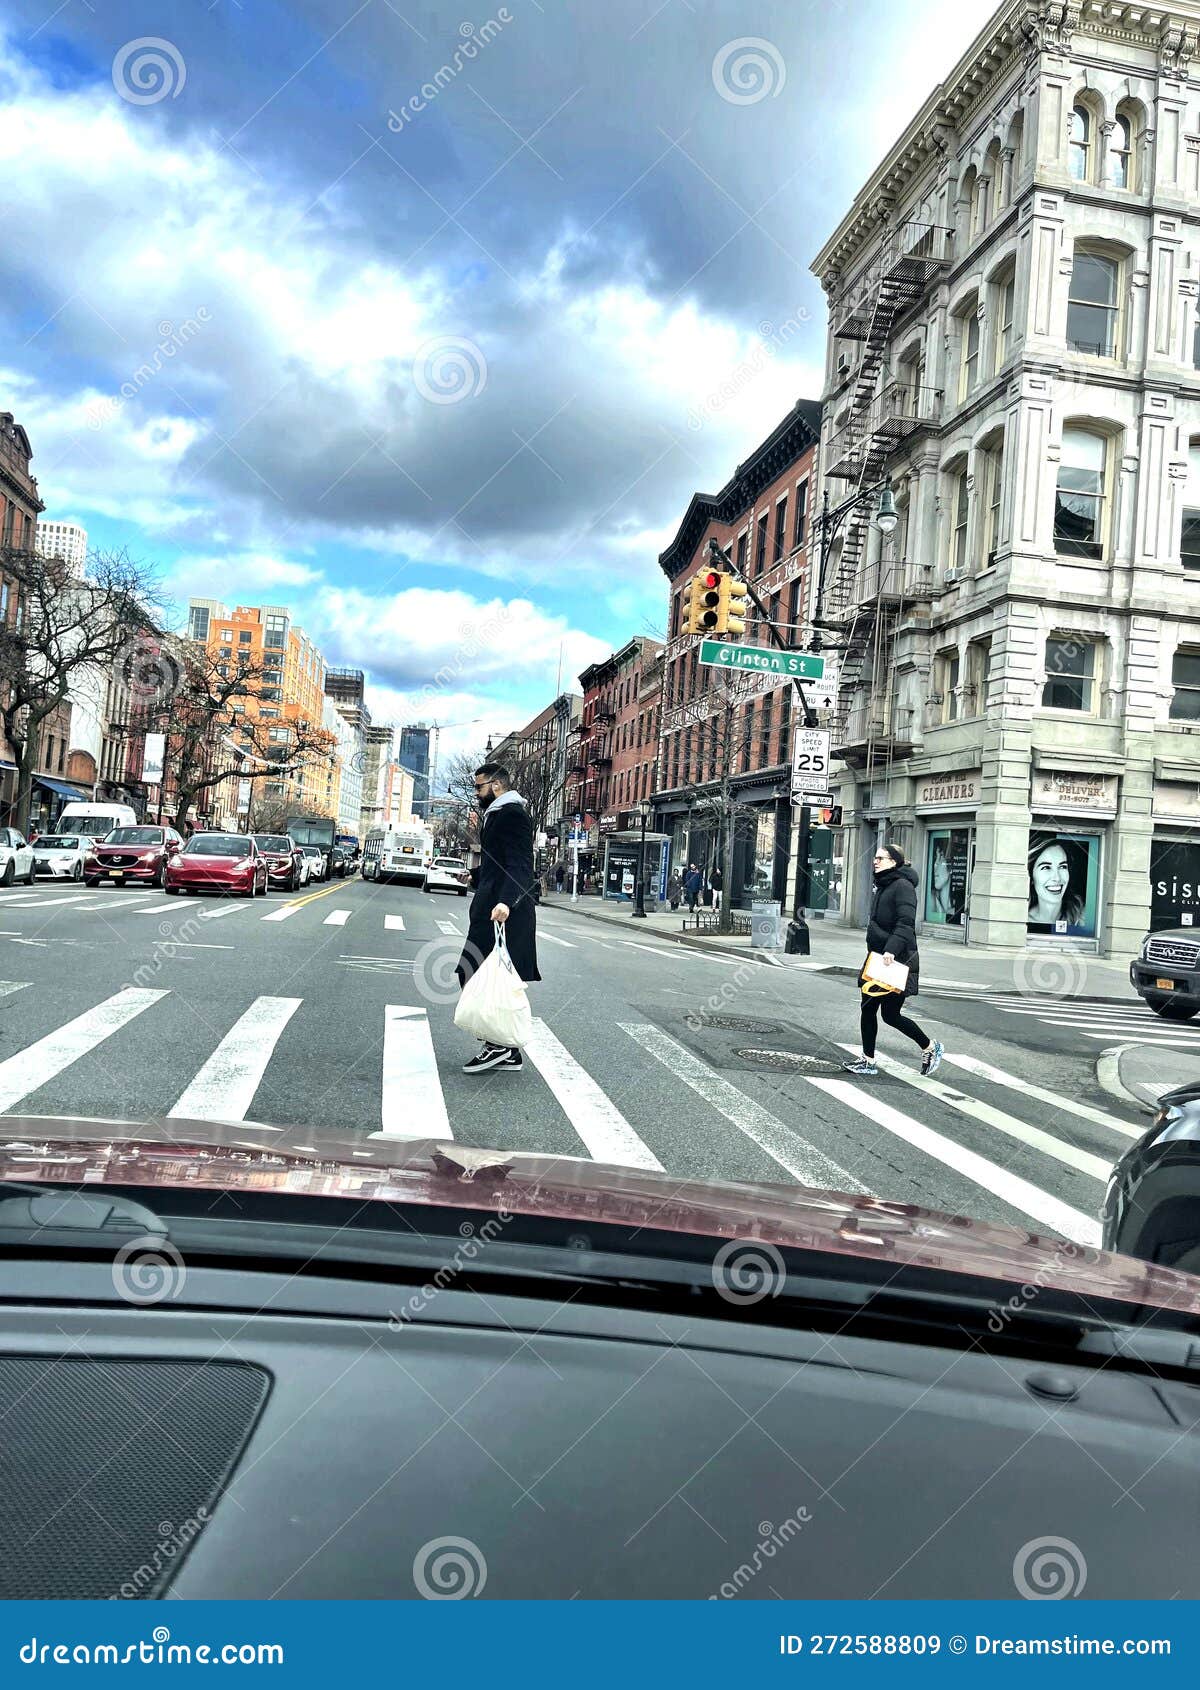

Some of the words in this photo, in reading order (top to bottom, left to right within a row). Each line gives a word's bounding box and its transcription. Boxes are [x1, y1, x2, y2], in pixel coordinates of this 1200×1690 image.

[719, 648, 780, 669] Clinton
[788, 658, 806, 673] St
[816, 682, 835, 691] ROUTE
[796, 696, 816, 705] TRU
[801, 738, 822, 746] SPEED
[798, 754, 824, 772] 25
[923, 783, 975, 801] CLEANERS
[795, 795, 809, 803] ONE
